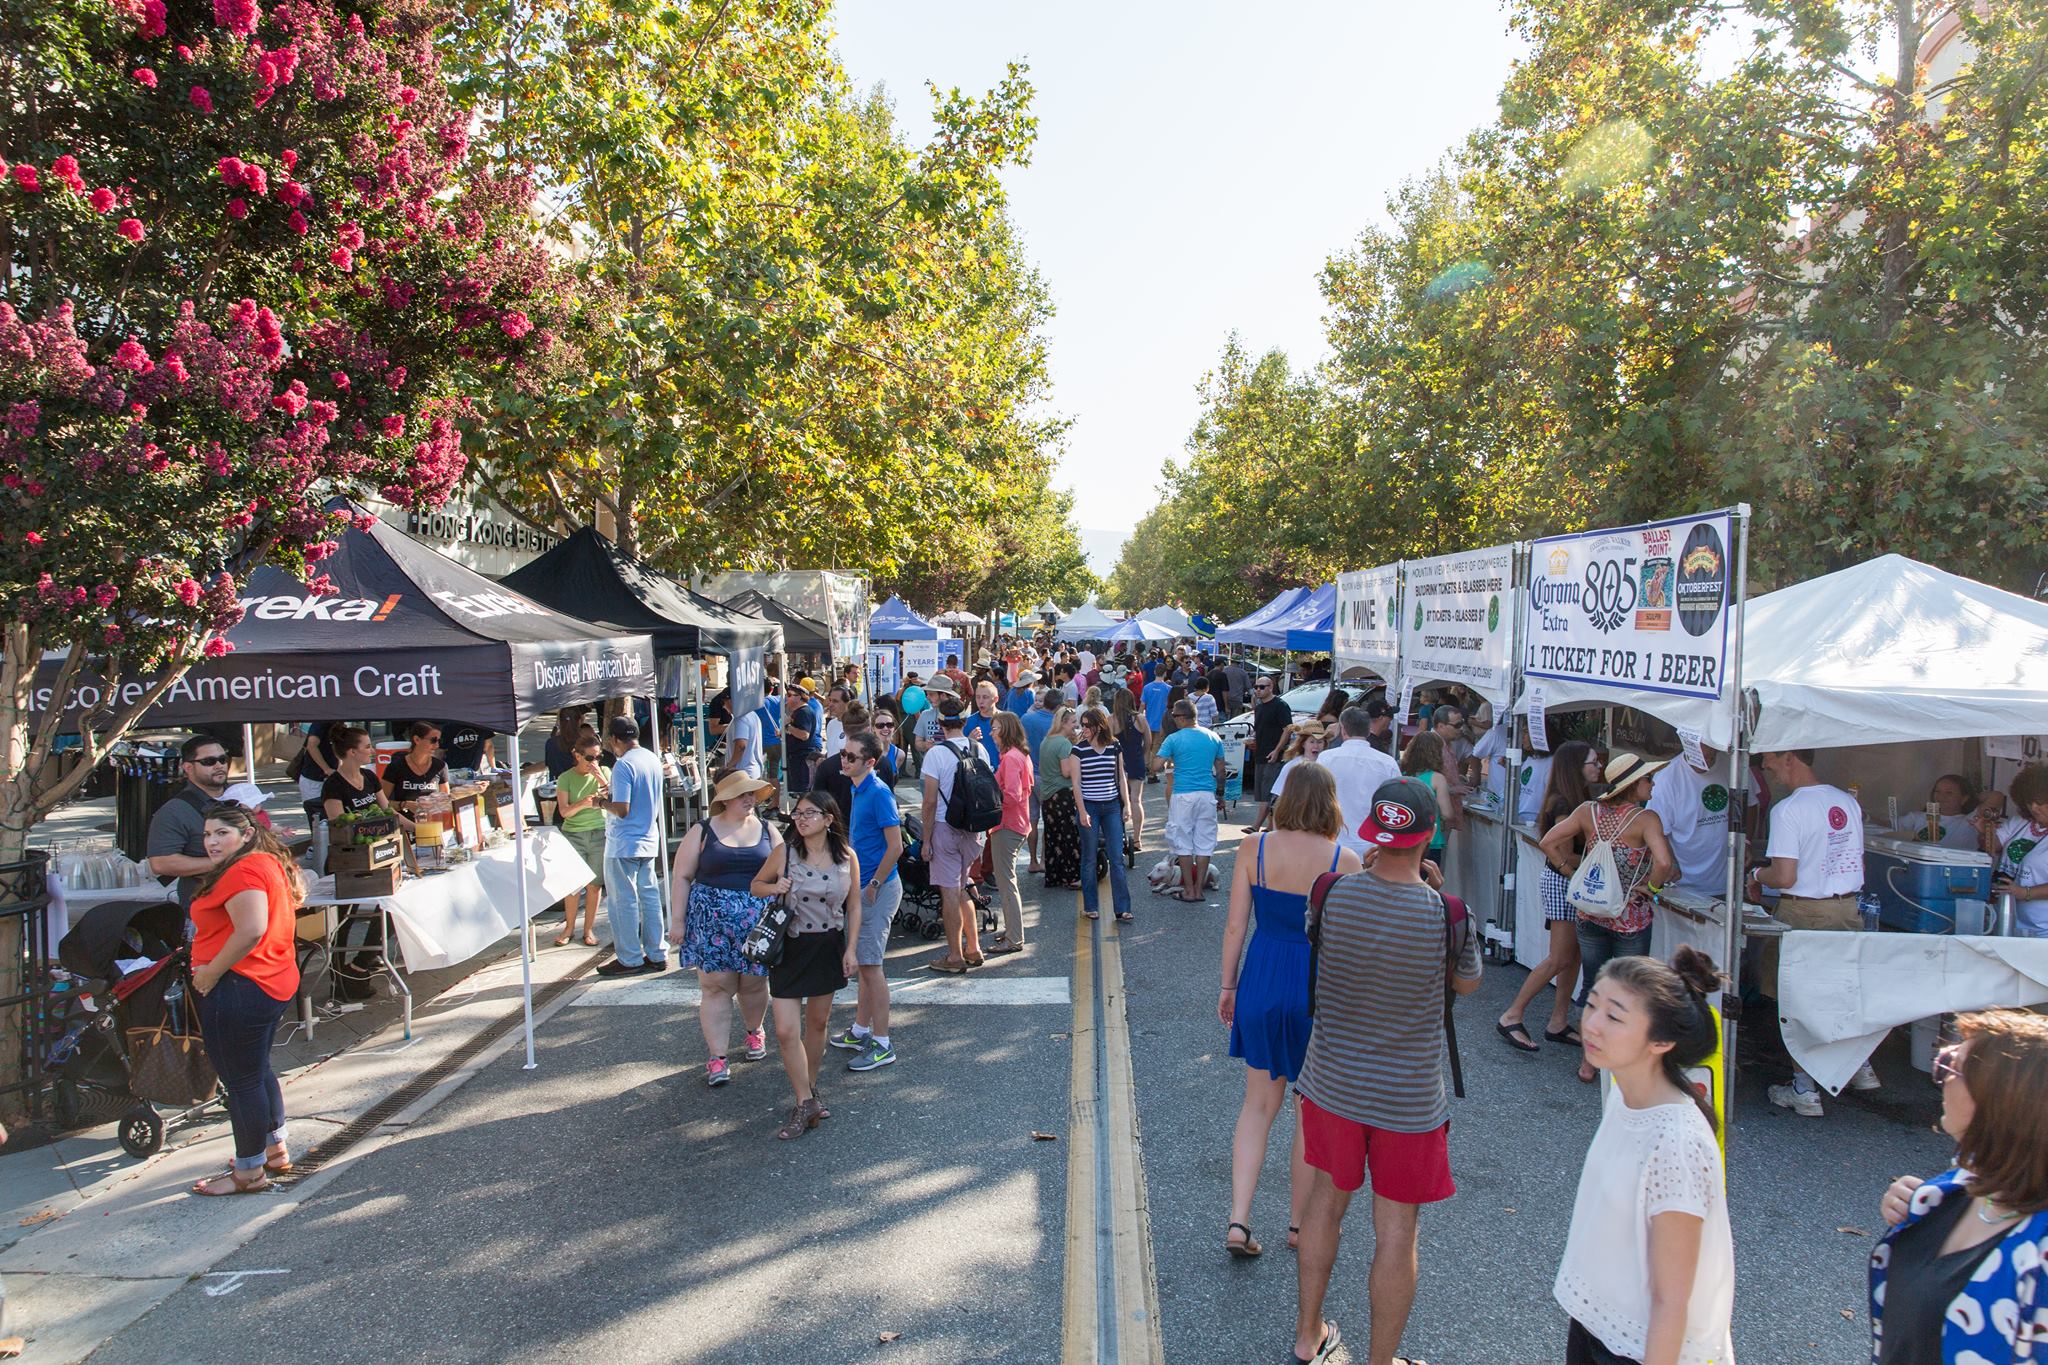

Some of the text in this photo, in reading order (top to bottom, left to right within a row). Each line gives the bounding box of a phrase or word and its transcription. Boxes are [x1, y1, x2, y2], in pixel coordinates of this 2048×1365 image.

[418, 511, 558, 551] HONG KONG BISTR
[1642, 530, 1672, 544] BALLAST
[1648, 543, 1669, 556] POINT
[1439, 581, 1457, 594] TICKETS
[1463, 579, 1486, 593] GLASSES
[1487, 578, 1502, 591] HERE
[1532, 575, 1580, 613] Corona
[1582, 558, 1637, 614] 805
[1678, 581, 1722, 594] OKTOBERFEST
[238, 594, 402, 622] reka!
[1353, 599, 1375, 630] WINE
[1432, 609, 1451, 622] TICKETS
[1455, 609, 1478, 622] GLASSES
[1543, 608, 1568, 631] Extra
[1440, 636, 1457, 649] CARDS
[534, 652, 643, 690] Discover American Craft
[1529, 645, 1716, 688] 1 TICKET FOR 1 BEER
[168, 668, 340, 703] American
[354, 664, 443, 697] Craft
